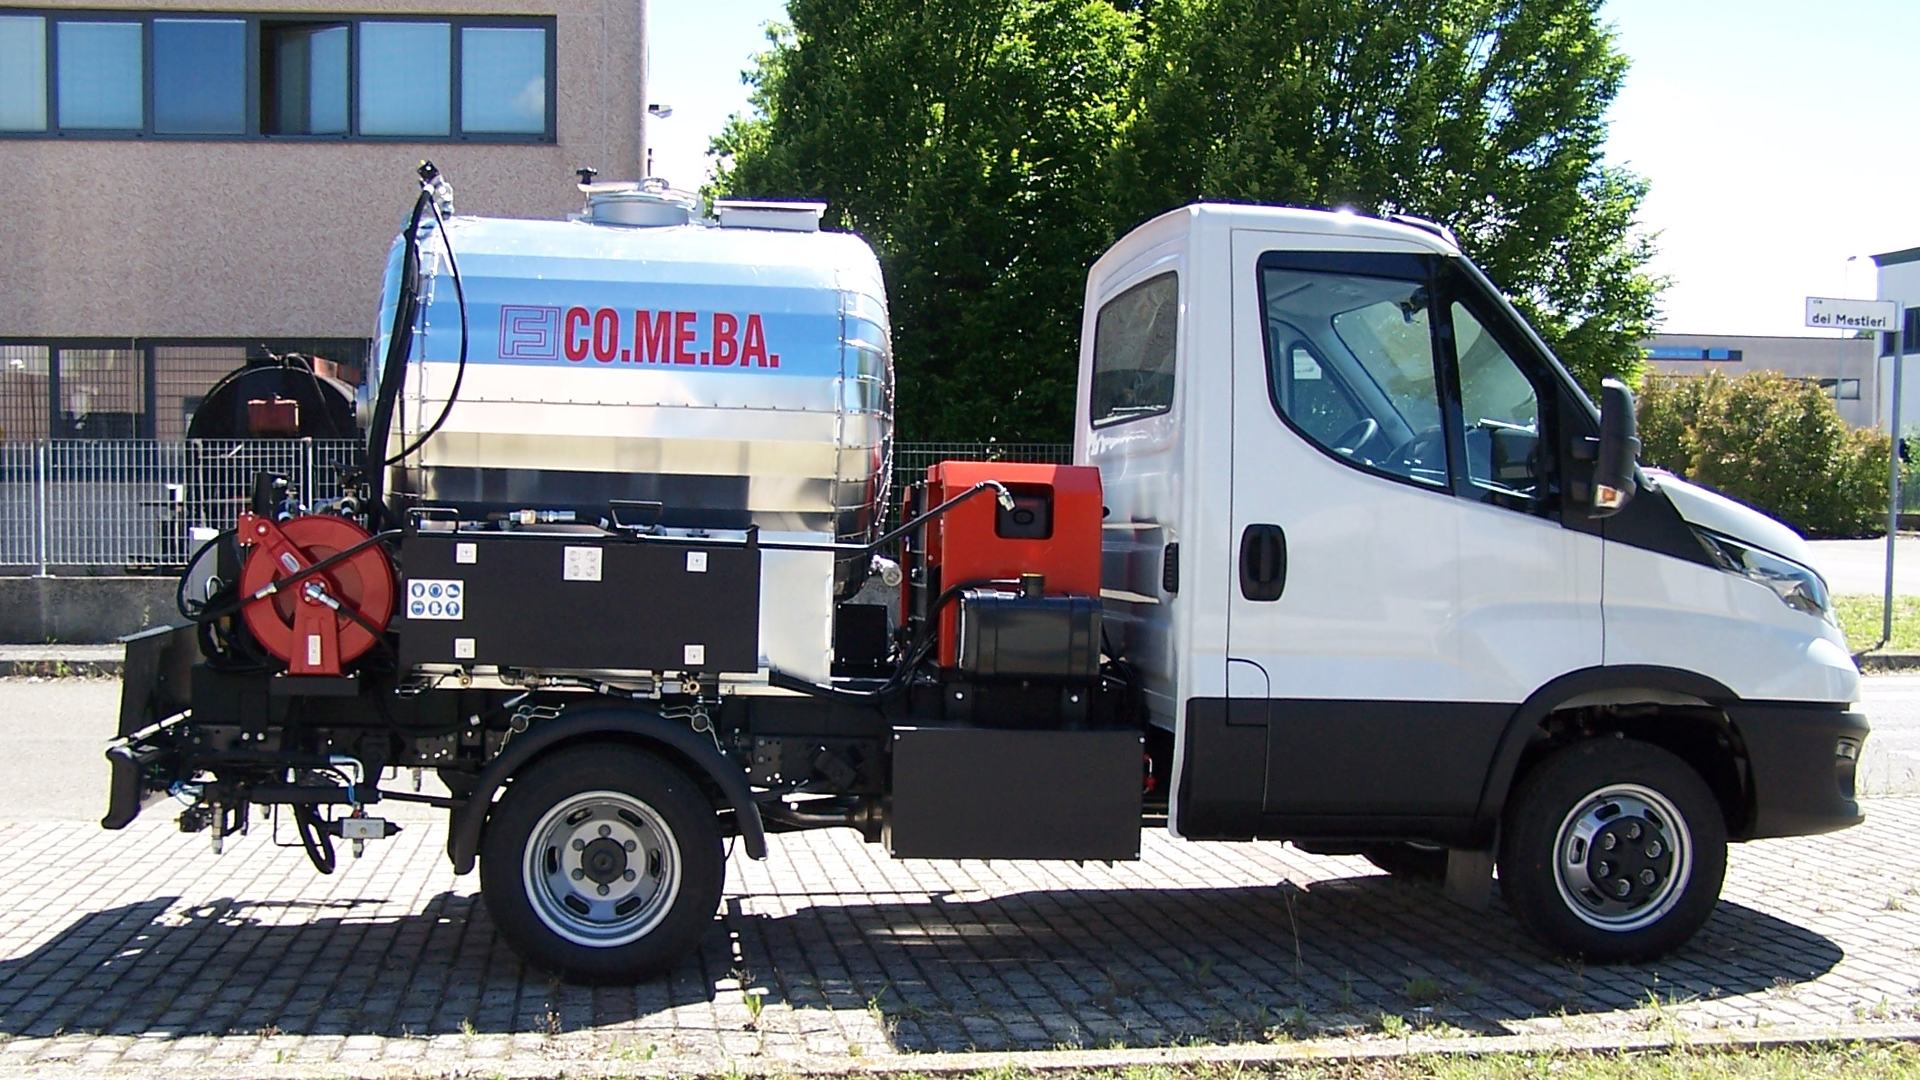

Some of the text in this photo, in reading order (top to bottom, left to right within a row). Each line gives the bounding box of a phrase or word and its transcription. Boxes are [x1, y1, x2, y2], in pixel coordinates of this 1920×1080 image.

[564, 306, 780, 368] CO.ME.BA.
[1812, 313, 1886, 327] dei Mestieri
